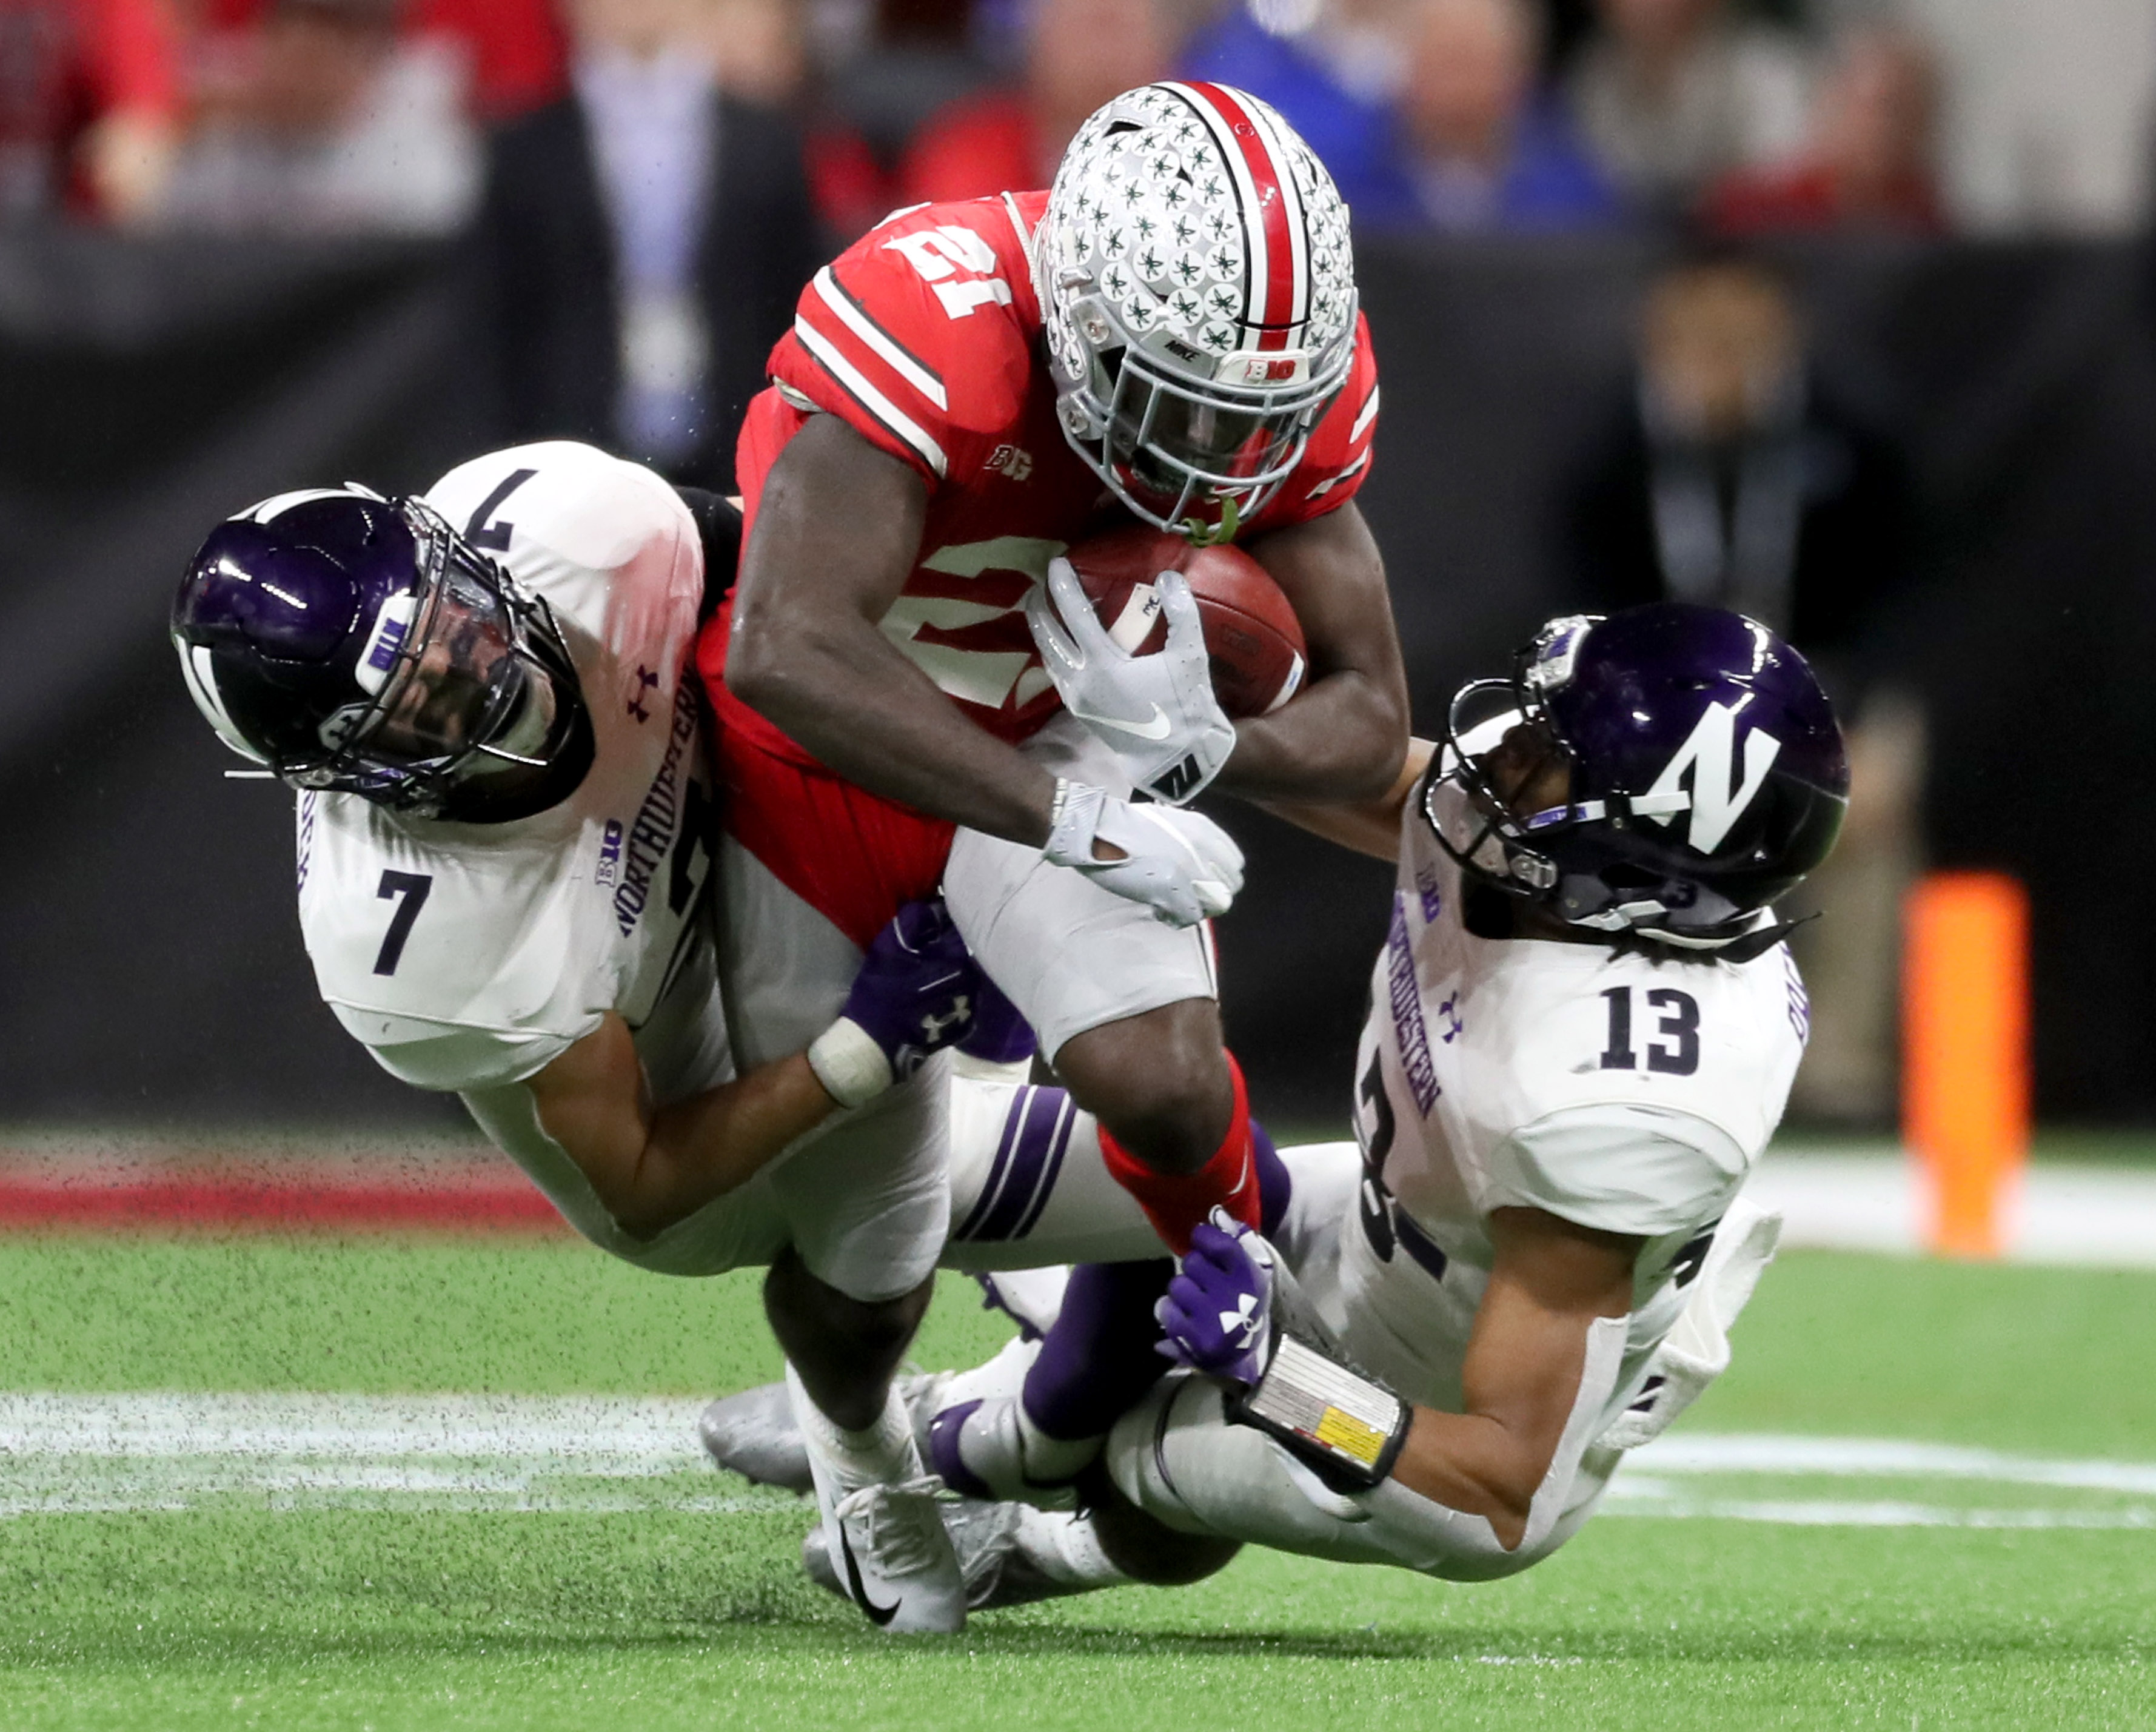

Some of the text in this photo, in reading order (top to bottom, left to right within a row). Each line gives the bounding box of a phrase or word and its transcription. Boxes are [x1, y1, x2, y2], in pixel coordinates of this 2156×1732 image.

[881, 225, 1012, 320] 21
[463, 469, 539, 552] 7
[1647, 701, 1781, 854] N
[373, 870, 433, 976] 7
[1600, 987, 1699, 1076] 13
